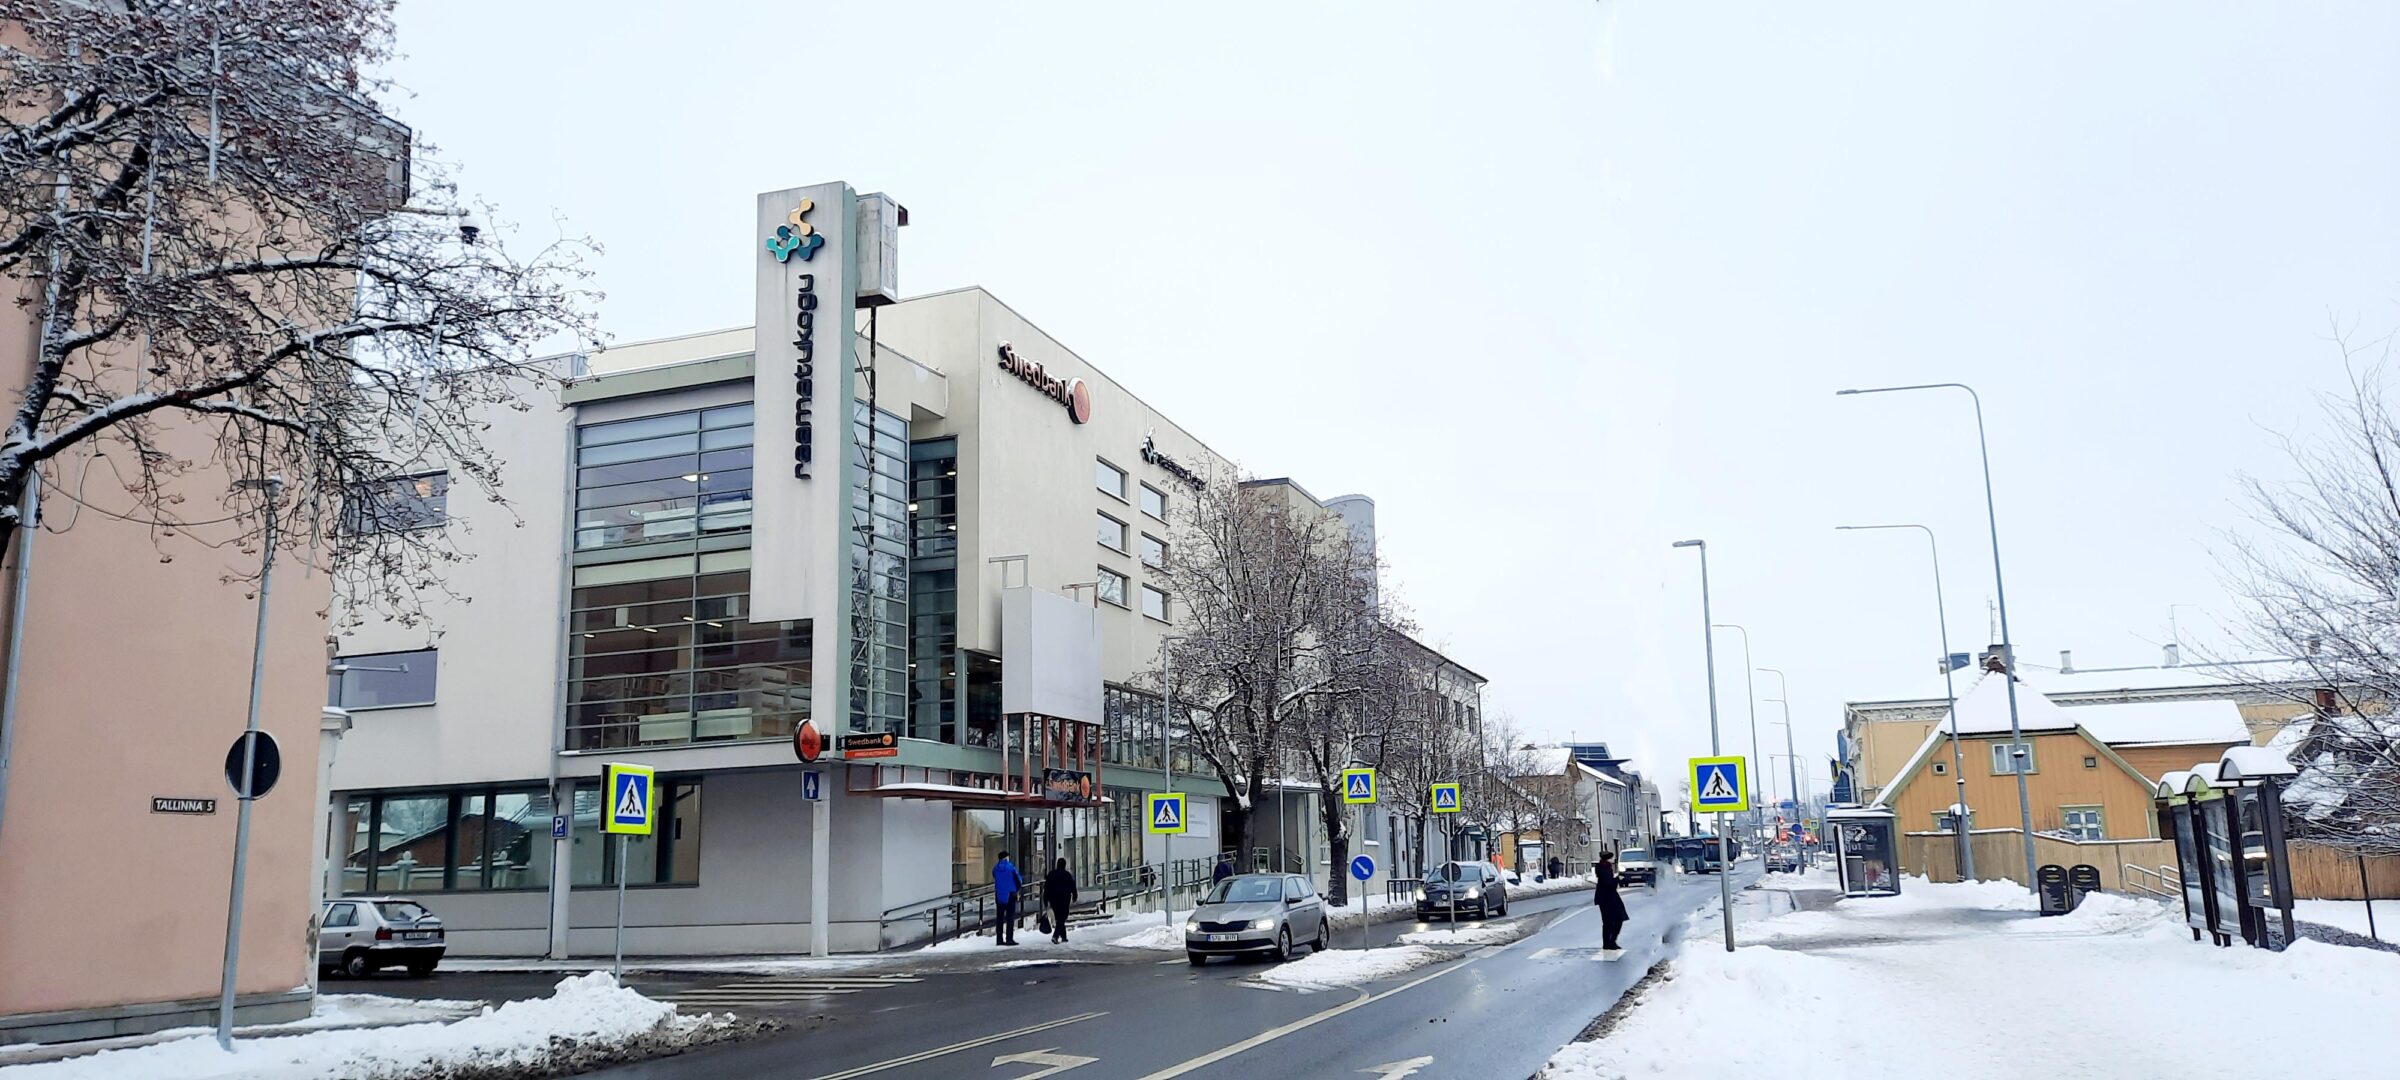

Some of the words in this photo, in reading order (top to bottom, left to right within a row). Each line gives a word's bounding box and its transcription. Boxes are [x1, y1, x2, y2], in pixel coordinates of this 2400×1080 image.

[793, 274, 818, 480] raamatukogu
[998, 341, 1071, 407] Swedbank
[848, 737, 881, 746] Swedbank
[155, 800, 203, 811] TALLINNA
[206, 801, 213, 811] 5
[555, 818, 564, 832] P
